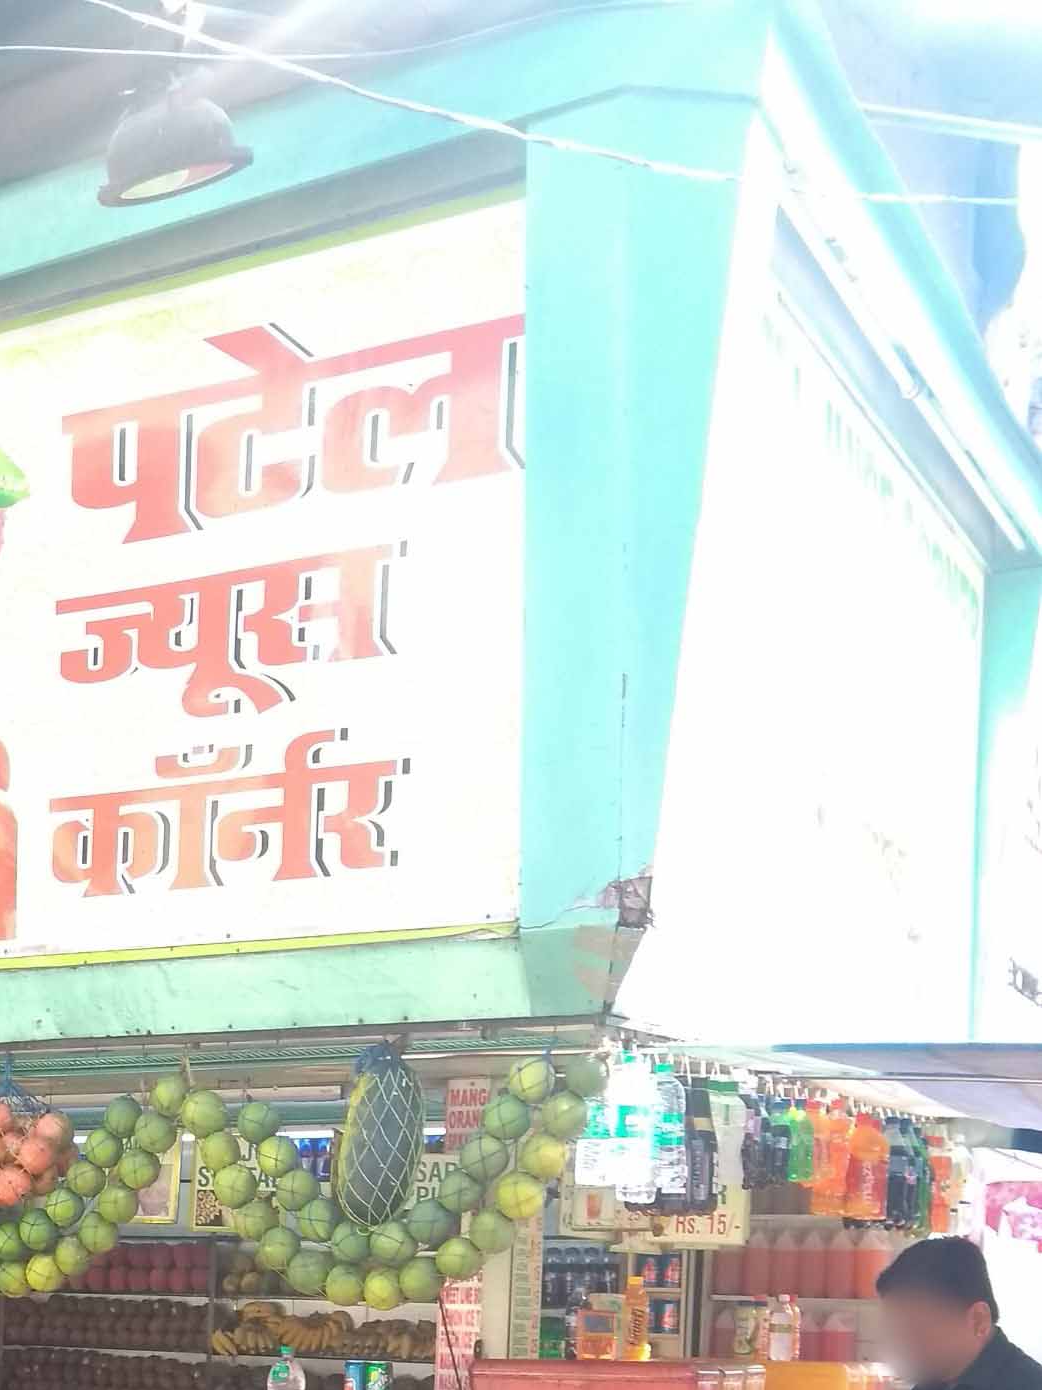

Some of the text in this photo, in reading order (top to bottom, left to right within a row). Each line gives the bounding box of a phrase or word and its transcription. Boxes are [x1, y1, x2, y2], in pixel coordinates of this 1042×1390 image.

[61, 313, 525, 544] पटेल
[55, 540, 408, 718] ज्यूस
[49, 727, 411, 898] कॉर्नर
[450, 1088, 487, 1105] MANG
